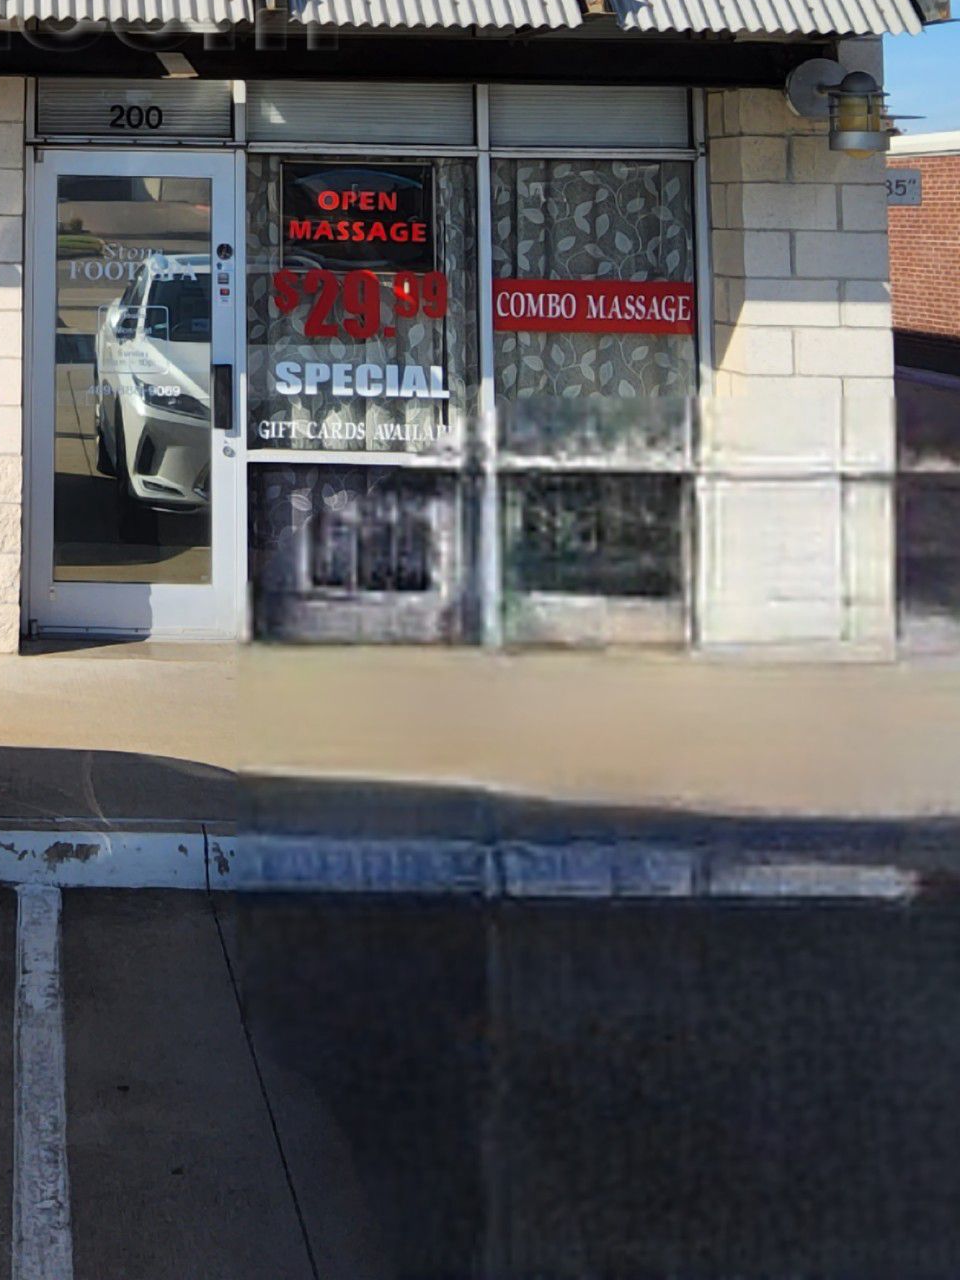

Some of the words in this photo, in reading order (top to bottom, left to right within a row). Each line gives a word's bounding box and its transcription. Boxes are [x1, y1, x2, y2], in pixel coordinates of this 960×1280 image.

[109, 105, 163, 129] 200
[317, 190, 398, 211] OPEN
[289, 220, 428, 242] MASSAGE
[70, 260, 140, 280] FOOT
[496, 291, 577, 319] COMBO
[586, 294, 691, 323] MASSAGE
[275, 361, 450, 398] SPECIAL
[258, 419, 296, 439] GIFT
[306, 421, 366, 440] CARDS
